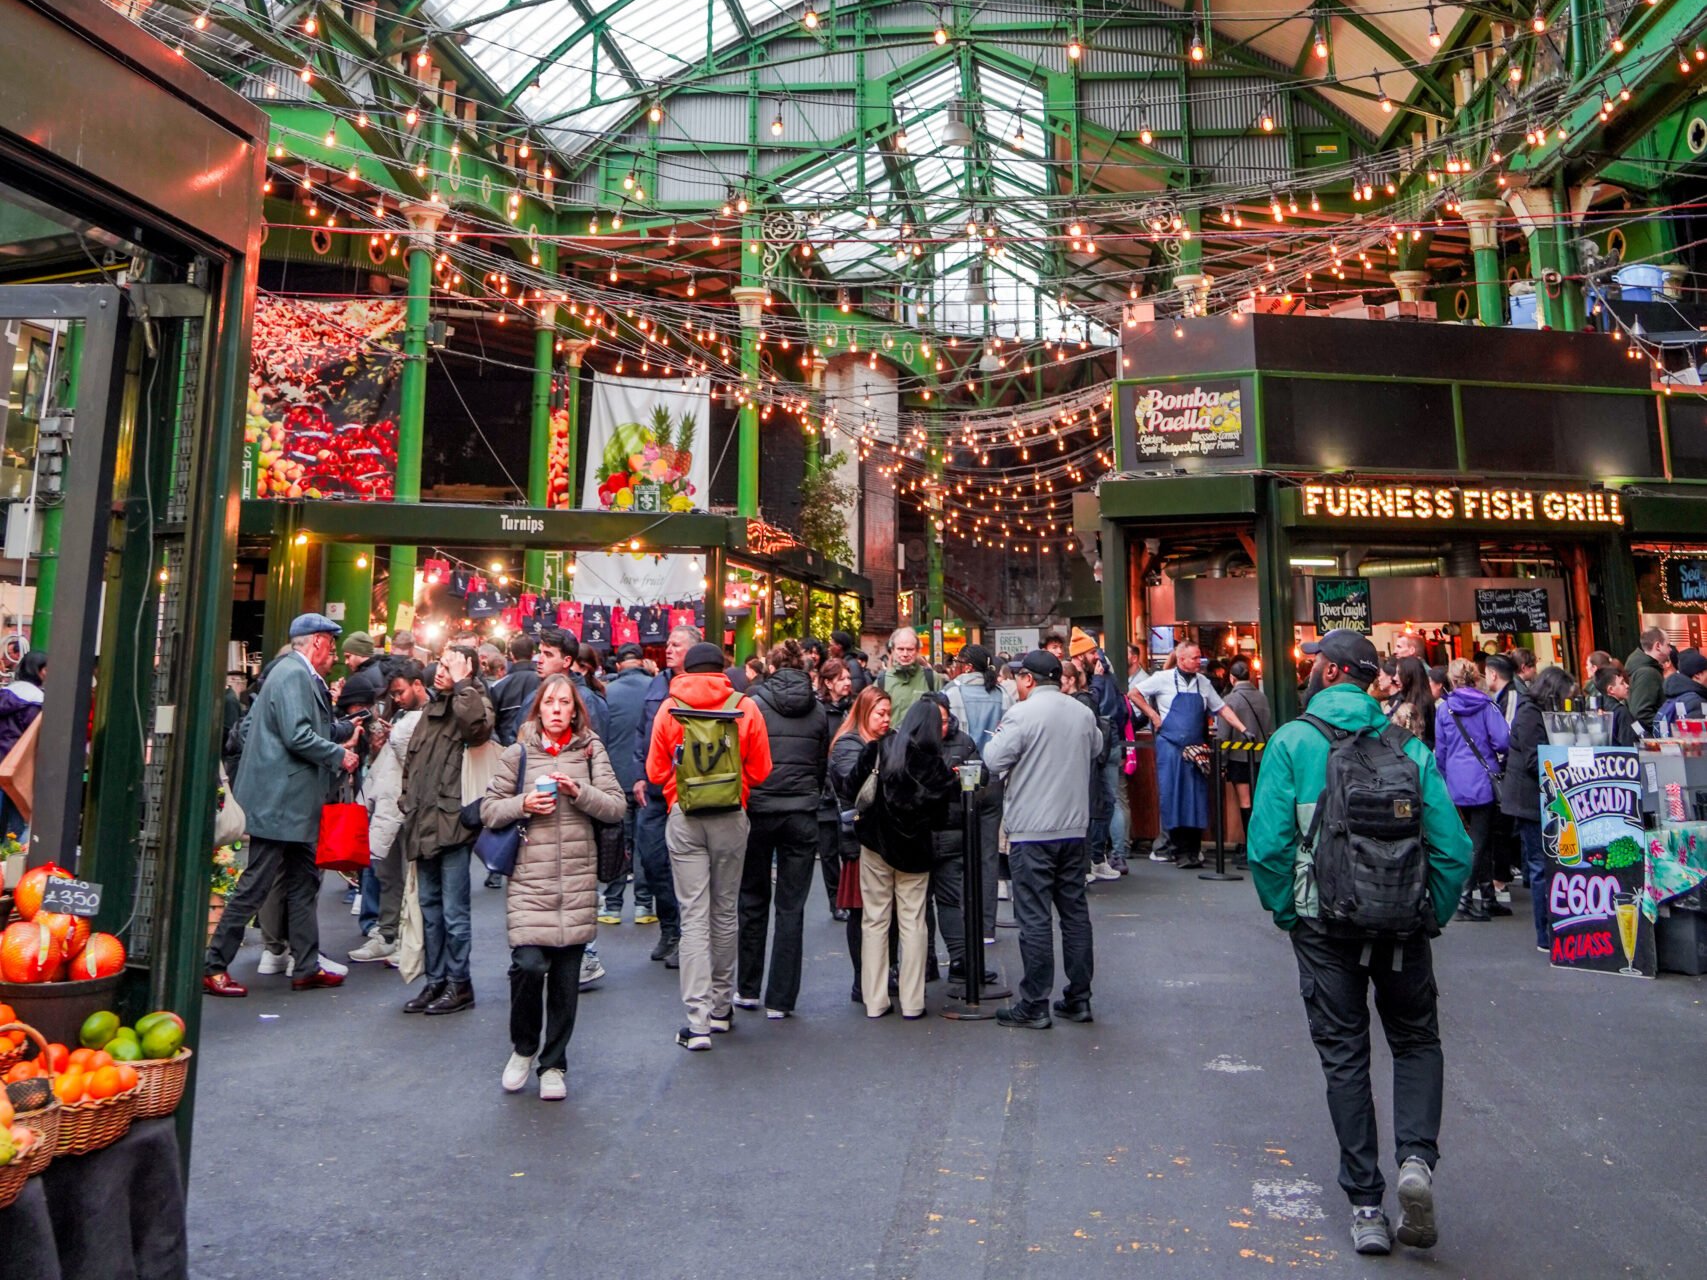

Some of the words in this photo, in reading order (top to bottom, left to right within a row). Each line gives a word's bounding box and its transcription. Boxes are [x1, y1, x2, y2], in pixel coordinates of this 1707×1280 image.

[1147, 387, 1220, 411] Bomba
[1146, 409, 1212, 433] Paella
[1304, 485, 1455, 520] FURNESS
[1463, 489, 1535, 521] FISH
[1541, 491, 1626, 526] GRILL
[501, 515, 545, 533] Turnips
[1679, 564, 1700, 582] Sea
[1320, 603, 1341, 616] Diver
[1341, 602, 1366, 620] Caught
[1000, 636, 1022, 645] GREEN
[1556, 756, 1639, 790] PROSECCO
[1570, 790, 1593, 821] ICE
[1590, 787, 1632, 817] COLD!
[1552, 936, 1564, 961] A
[1563, 930, 1615, 961] GLASS
